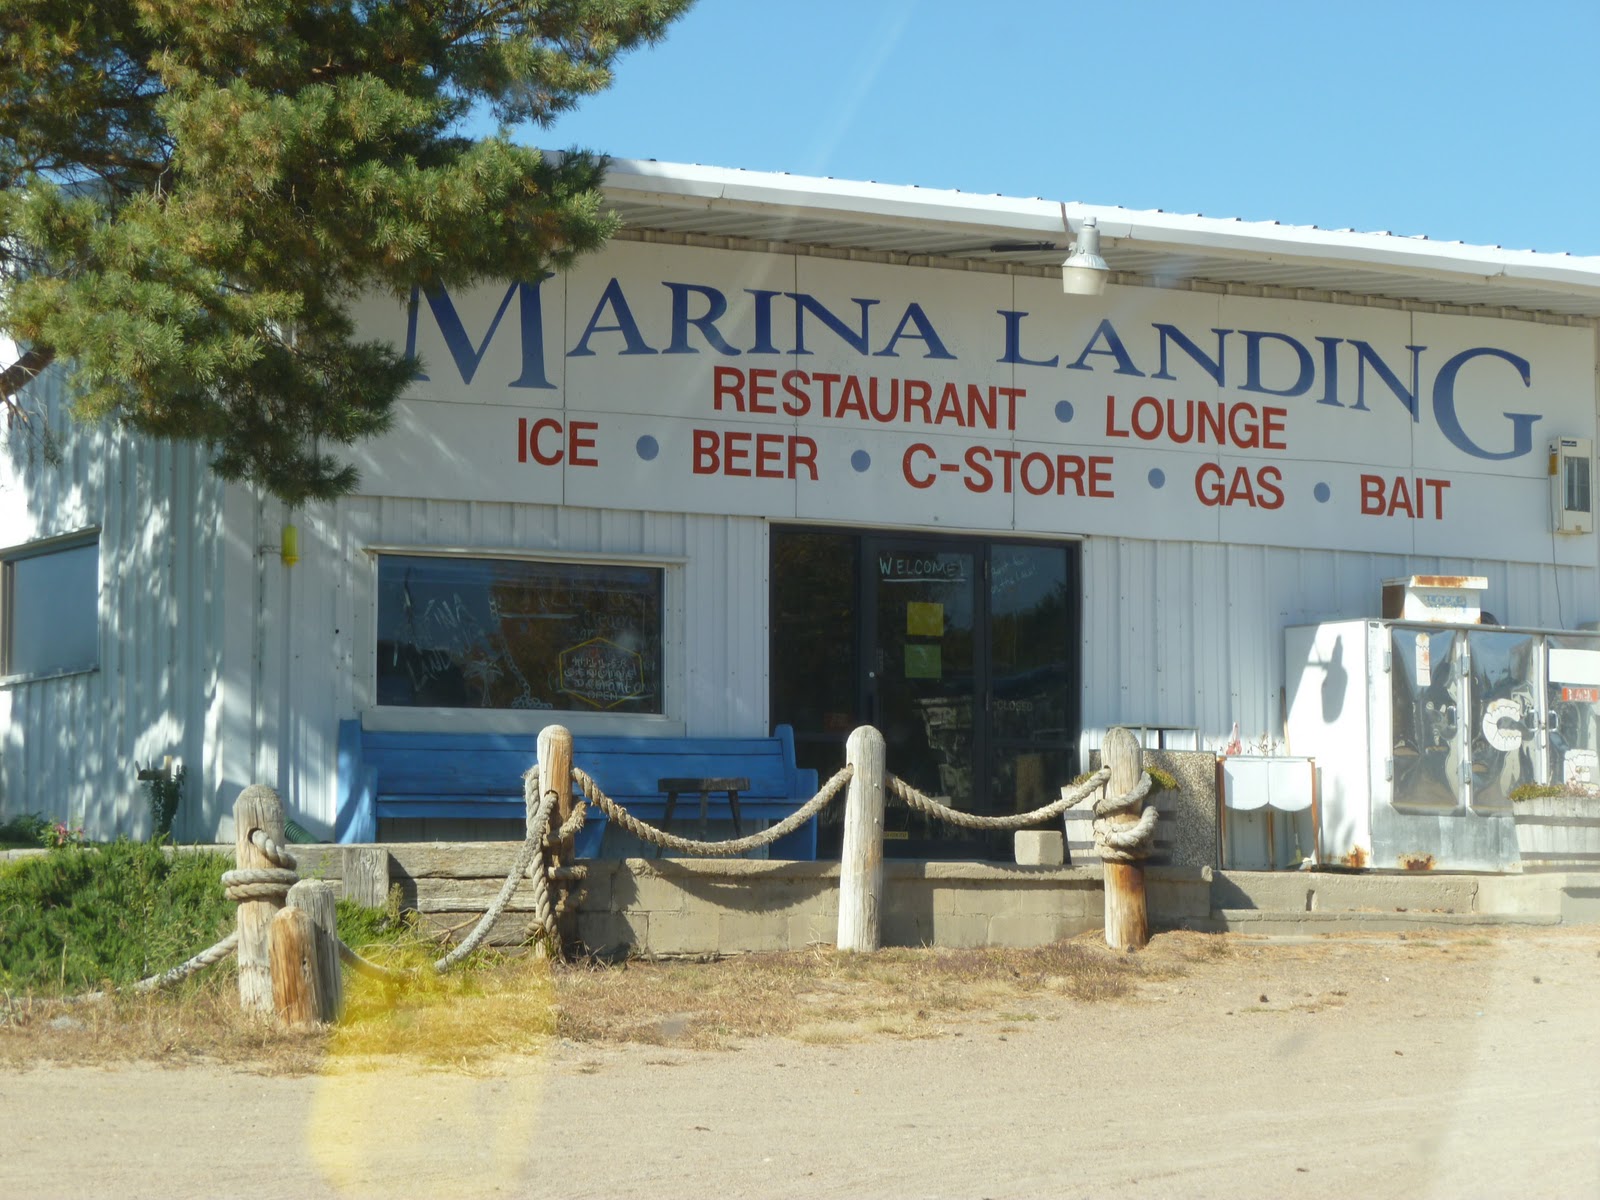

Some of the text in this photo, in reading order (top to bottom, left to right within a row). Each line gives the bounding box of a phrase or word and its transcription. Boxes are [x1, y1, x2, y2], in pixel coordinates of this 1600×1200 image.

[402, 272, 1543, 461] MARINA LANDING
[713, 366, 1288, 450] RESTAURANT LOUNGE
[518, 417, 1451, 520] ICE BEER C-STORE GAS BAIT
[879, 556, 968, 577] WELCOME!
